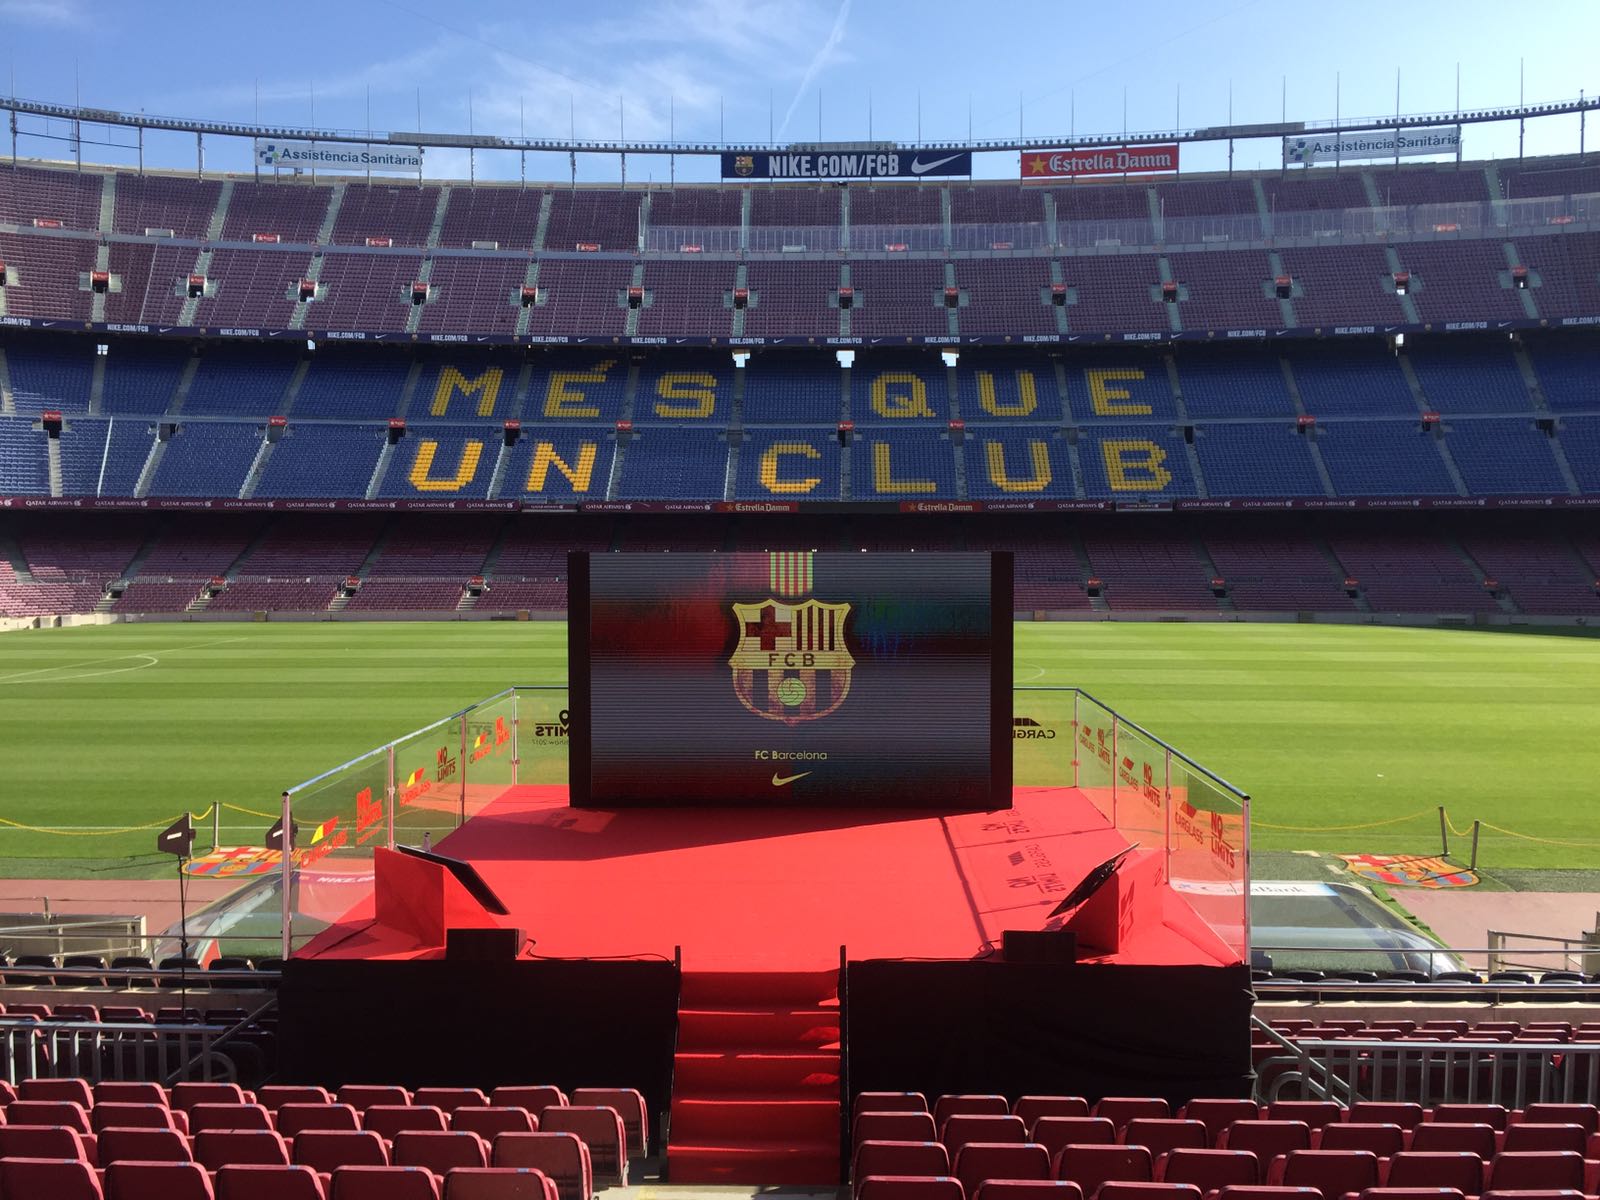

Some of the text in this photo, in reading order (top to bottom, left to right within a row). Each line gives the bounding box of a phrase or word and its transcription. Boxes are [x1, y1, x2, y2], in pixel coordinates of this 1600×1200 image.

[1313, 134, 1459, 153] Assistència Sanitària
[282, 148, 419, 166] Assistència Sanitària
[769, 154, 899, 176] NIKE.COM/FCB
[1049, 152, 1172, 172] Estrella Damm
[736, 503, 790, 512] Estrella Damm
[918, 503, 972, 511] Estrella Damm
[768, 653, 815, 667] FCB
[755, 750, 828, 760] FC Barcelona
[1175, 812, 1204, 846] CARGLASS
[1211, 836, 1234, 870] LIMITS
